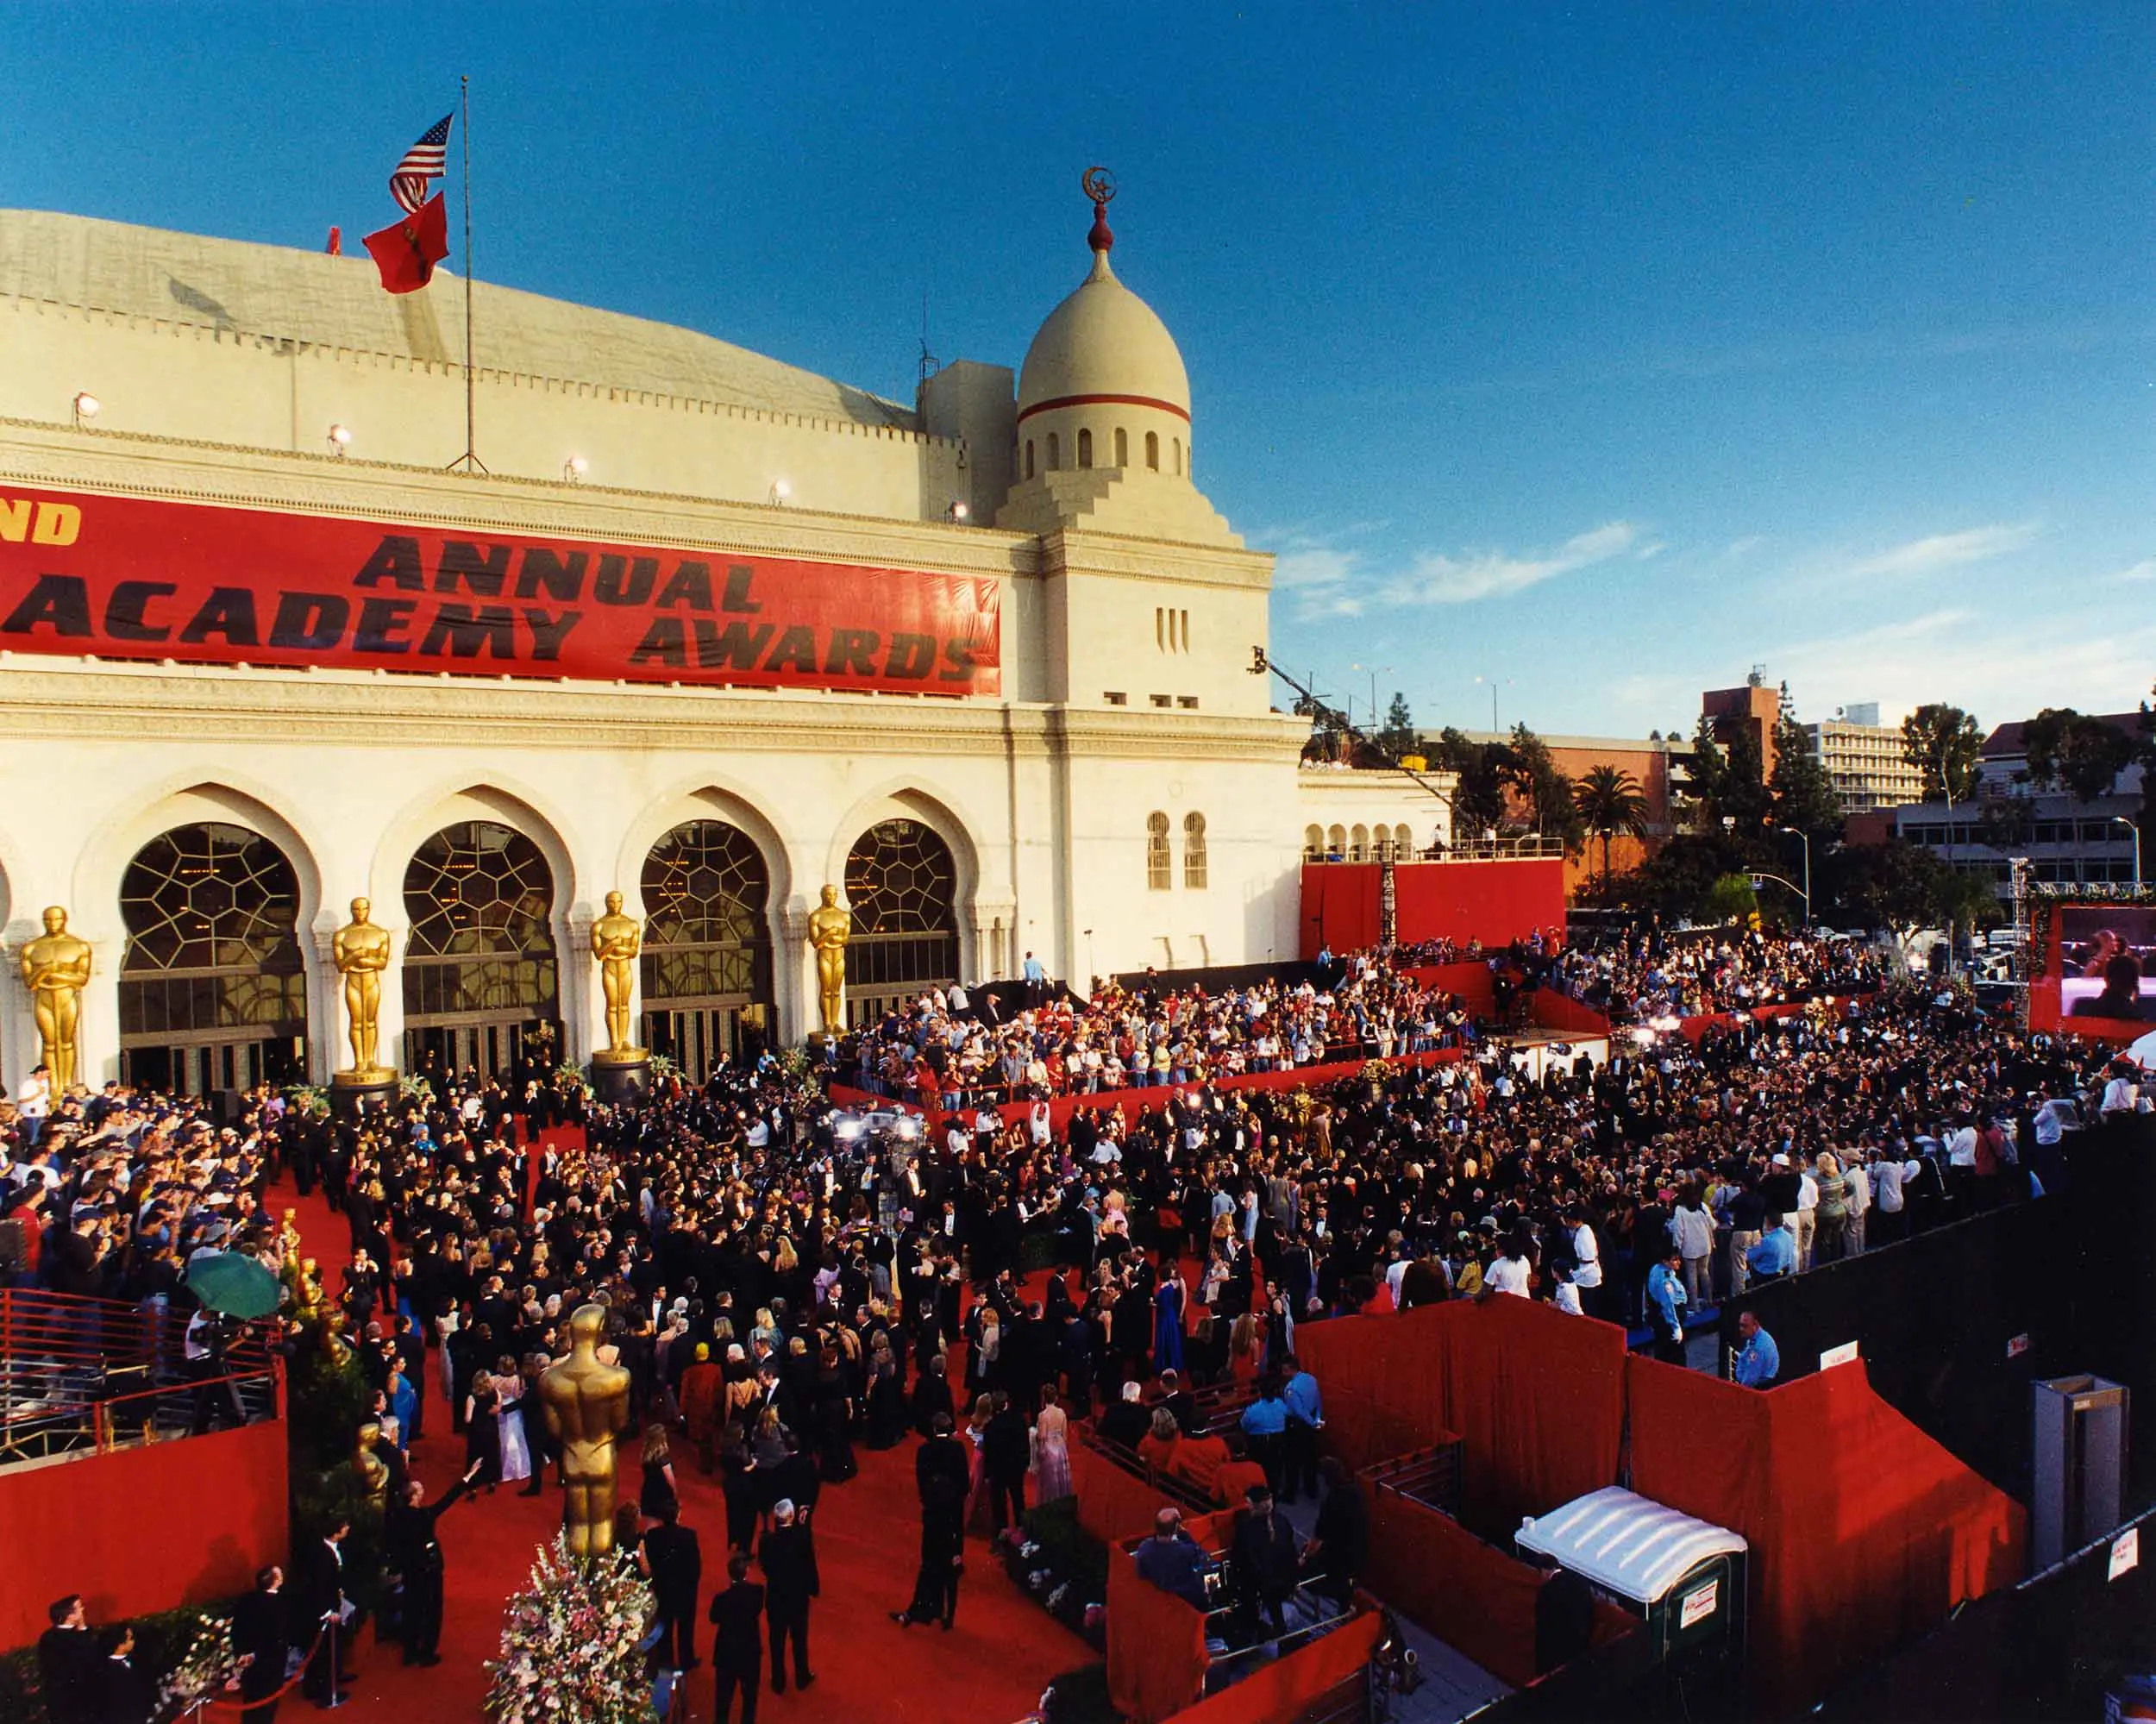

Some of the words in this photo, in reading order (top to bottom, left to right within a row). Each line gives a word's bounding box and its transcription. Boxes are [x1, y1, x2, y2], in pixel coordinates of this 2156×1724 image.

[0, 498, 81, 546] ND
[353, 535, 762, 613] ANNUAL
[2, 574, 580, 662] ACADEMY
[628, 618, 981, 681] AWARDS
